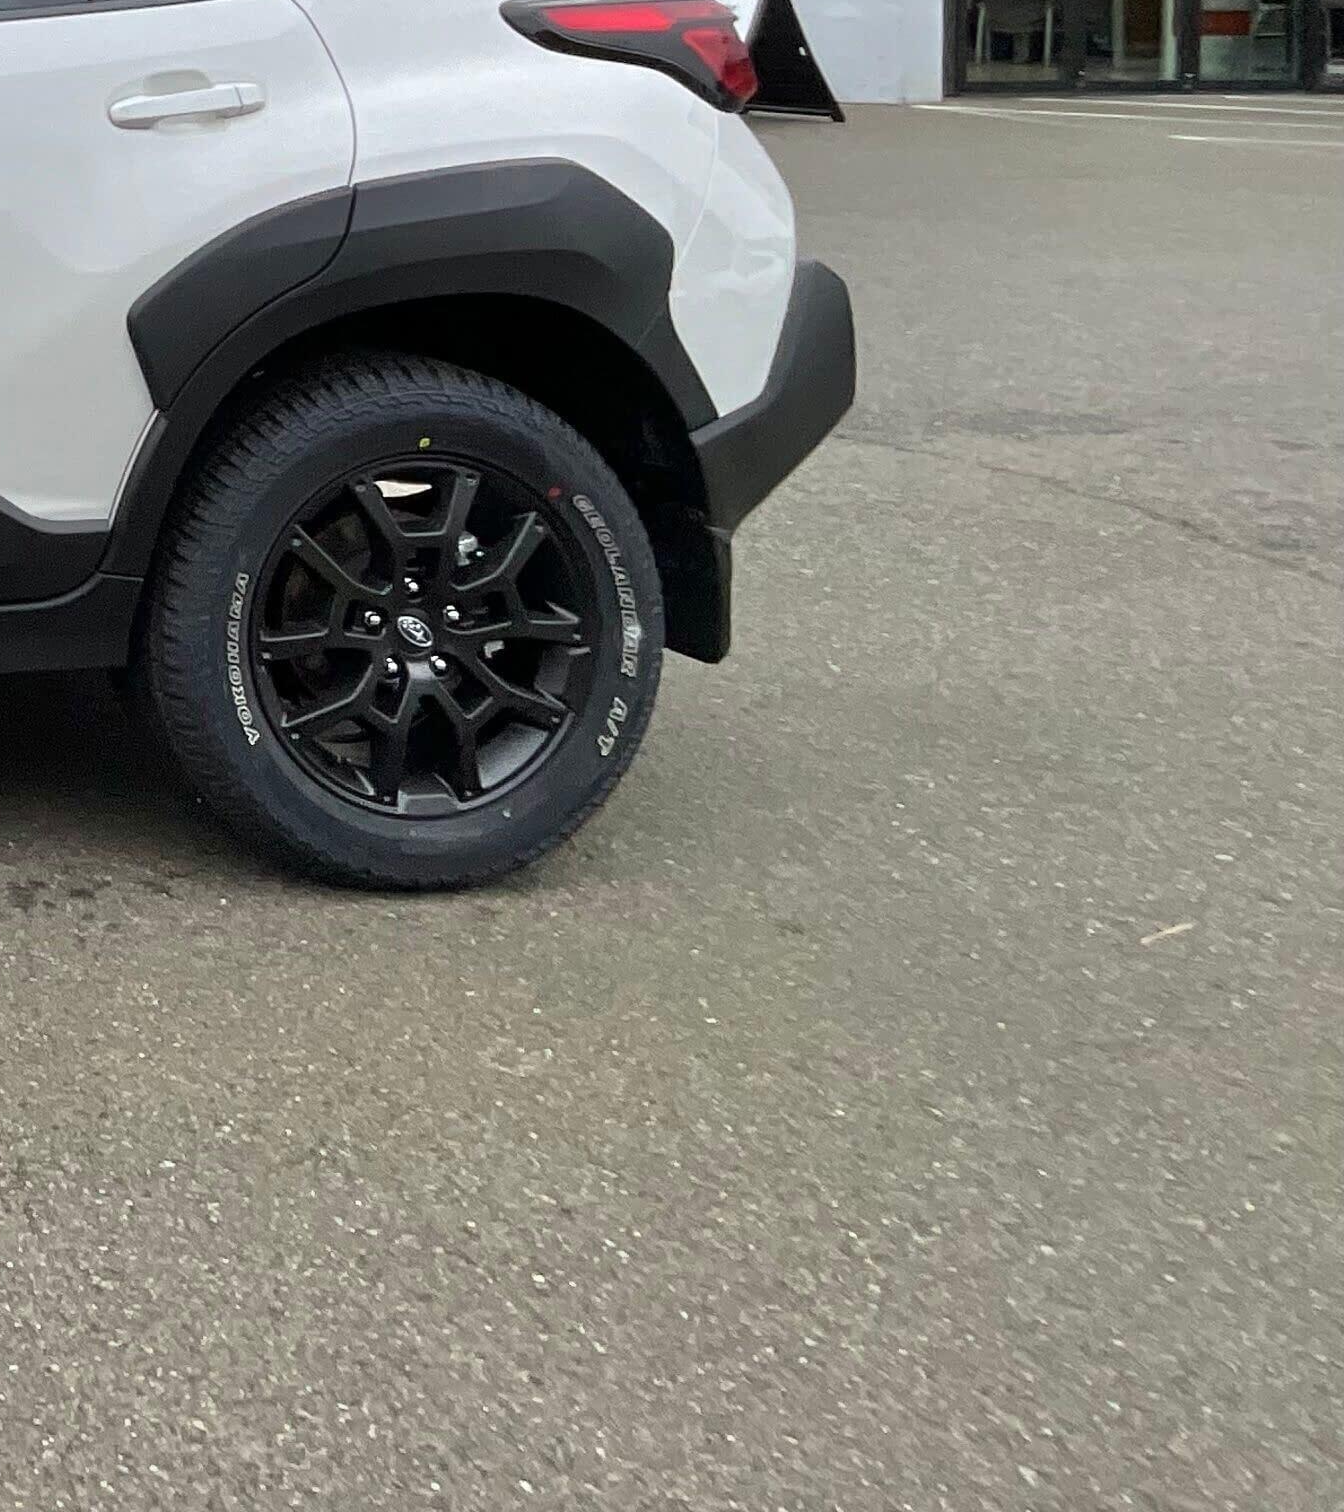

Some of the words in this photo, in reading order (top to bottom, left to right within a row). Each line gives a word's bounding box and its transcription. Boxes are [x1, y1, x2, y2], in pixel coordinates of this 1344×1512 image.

[226, 571, 260, 747] YOKOHAMA
[572, 493, 642, 678] GEOLANDAR
[596, 696, 629, 757] A/T
